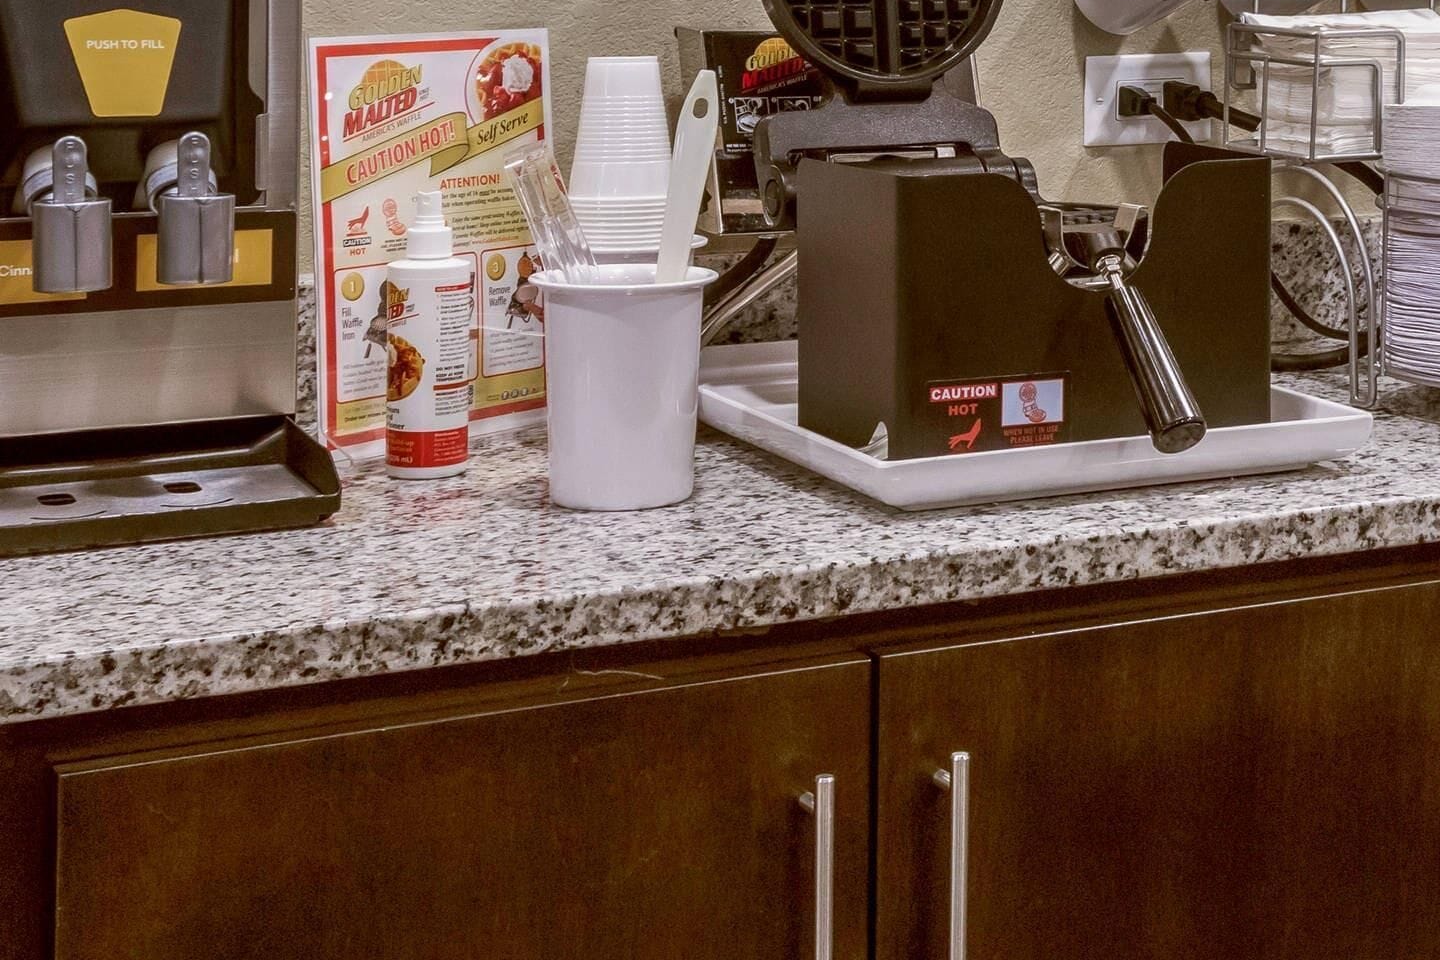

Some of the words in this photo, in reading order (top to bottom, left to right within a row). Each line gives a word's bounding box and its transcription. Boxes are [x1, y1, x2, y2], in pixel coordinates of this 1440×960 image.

[86, 39, 119, 49] PUSH
[120, 39, 138, 49] TO
[141, 39, 165, 49] FILL
[348, 63, 423, 110] GOLDEN
[343, 87, 417, 138] MALTED
[477, 126, 498, 145] Self
[499, 110, 529, 135] Serve
[346, 142, 418, 185] CAUTION
[419, 119, 456, 153] HOT!
[440, 174, 500, 189] ATTENTION!
[343, 237, 371, 247] CAUTION
[349, 248, 366, 256] HOT
[0, 265, 33, 277] Cinn
[493, 262, 499, 273] 3
[350, 281, 355, 292] 1
[488, 286, 511, 296] Remove
[489, 296, 507, 307] Waffle
[341, 306, 352, 317] Fill
[342, 317, 363, 329] Waffle
[342, 331, 356, 340] Iron
[930, 385, 996, 400] CAUTION
[948, 403, 979, 417] HOT
